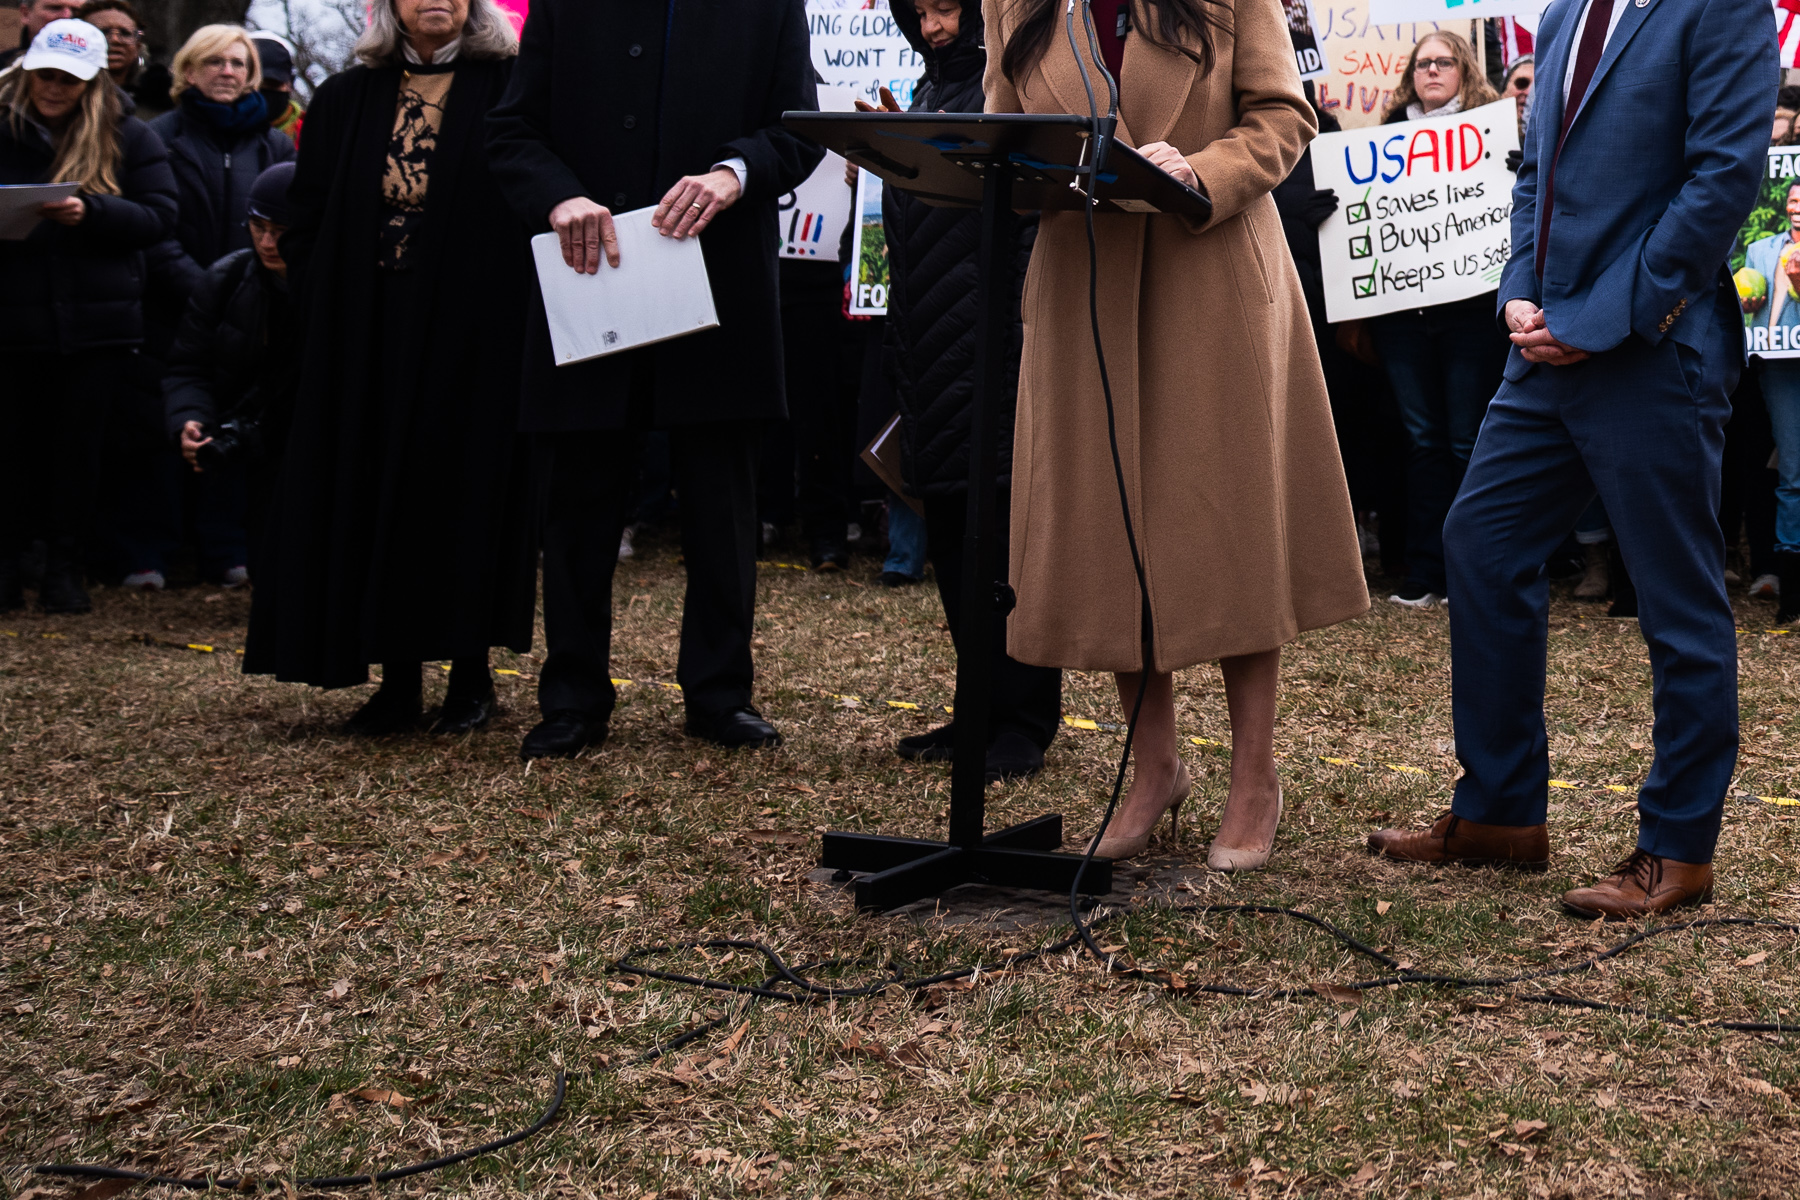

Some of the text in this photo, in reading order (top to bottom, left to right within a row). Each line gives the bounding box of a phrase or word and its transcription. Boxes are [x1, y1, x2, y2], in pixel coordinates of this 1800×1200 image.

[811, 14, 901, 37] ING GLOB
[824, 48, 885, 67] WON'T
[1297, 48, 1321, 73] ID
[1339, 50, 1406, 76] SAVE
[1345, 123, 1491, 185] USAID:
[1447, 182, 1485, 204] lives
[1380, 222, 1442, 253] Buys
[1380, 262, 1445, 294] Keeps
